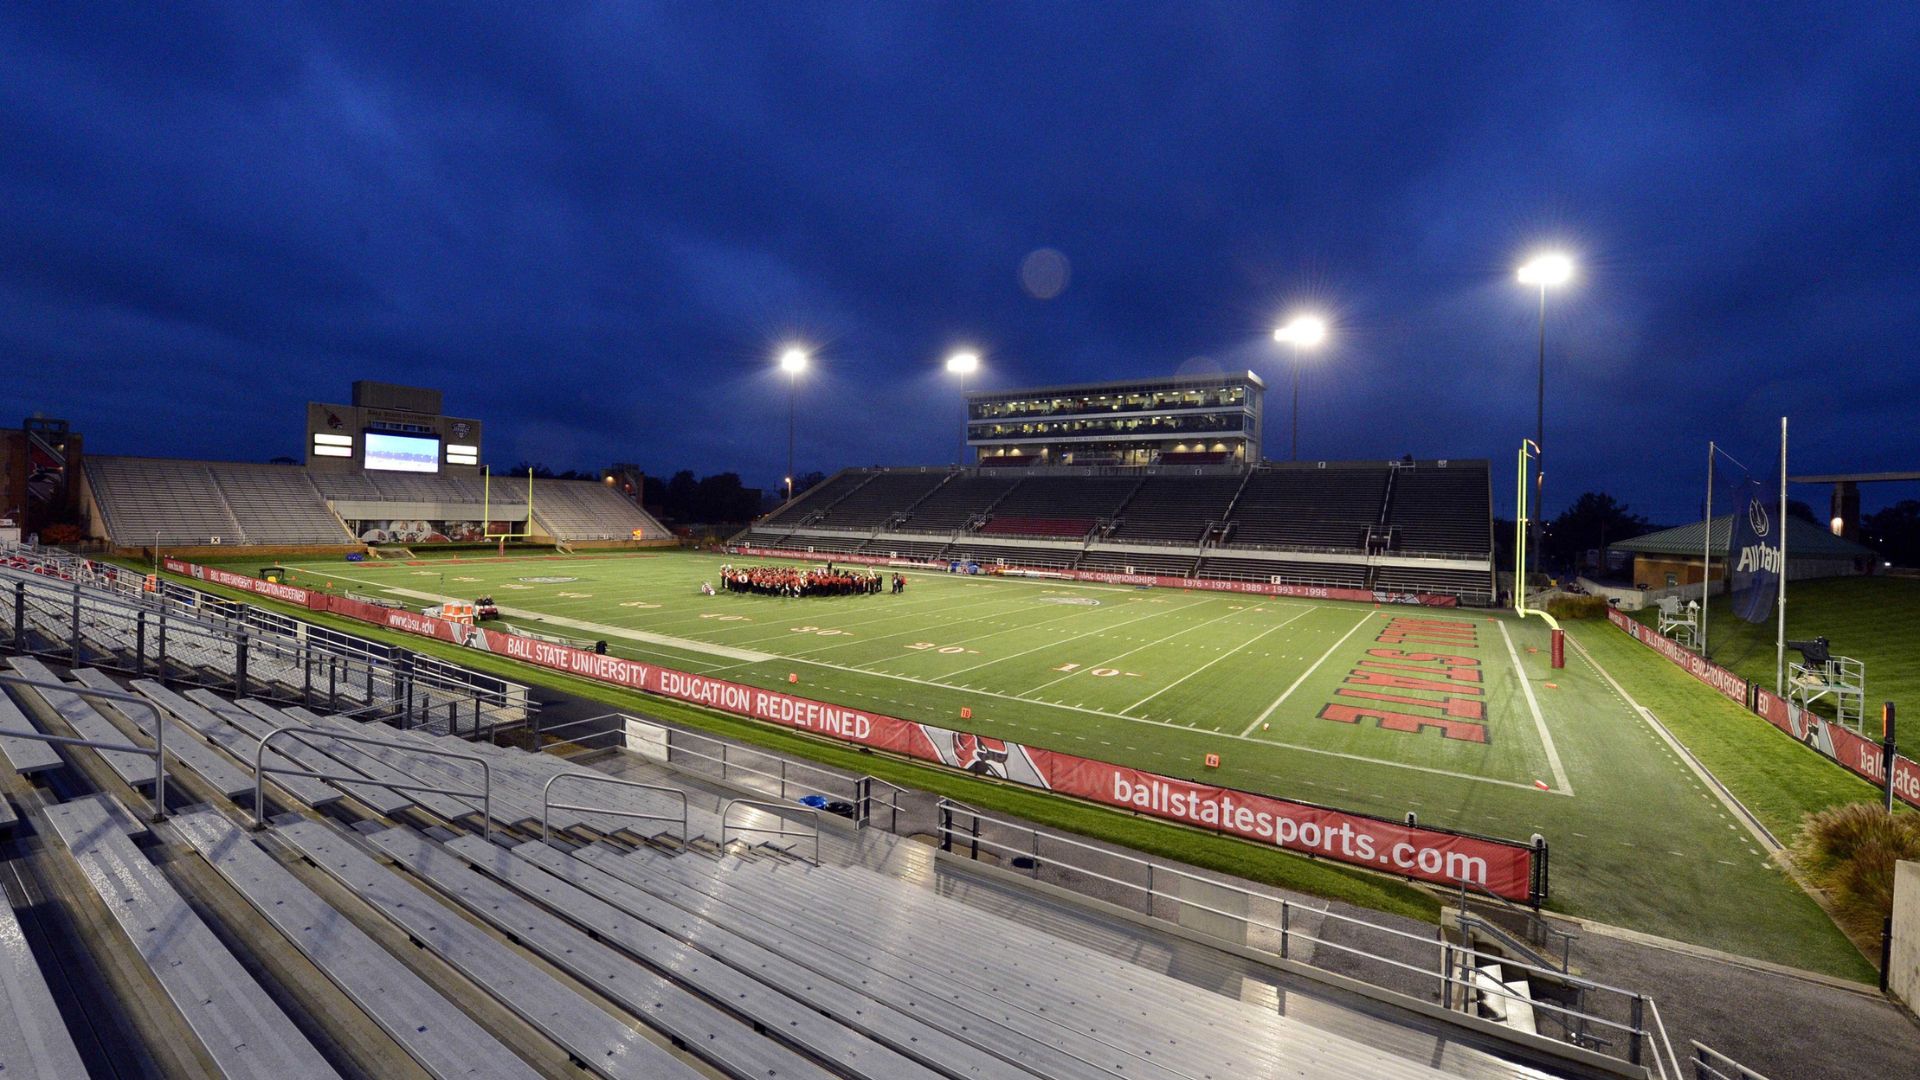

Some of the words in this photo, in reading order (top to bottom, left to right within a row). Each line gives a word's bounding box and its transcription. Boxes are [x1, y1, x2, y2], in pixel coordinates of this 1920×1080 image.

[1079, 571, 1094, 580] MAC
[1096, 572, 1157, 584] CHAMPIONSHIPS
[1183, 579, 1202, 588] 1976
[1211, 581, 1231, 590] 1978
[1241, 583, 1262, 592] 1989
[1273, 586, 1294, 594] 1993
[1304, 588, 1327, 596] 1996
[389, 614, 435, 635] www.bsu.edu
[508, 637, 531, 659] BALL
[536, 643, 568, 668] STATE
[572, 648, 648, 685] UNIVERSITY
[660, 671, 750, 711] EDUCATION
[756, 692, 871, 739] REDEFINED
[1114, 771, 1487, 884] ballstatesports.com
